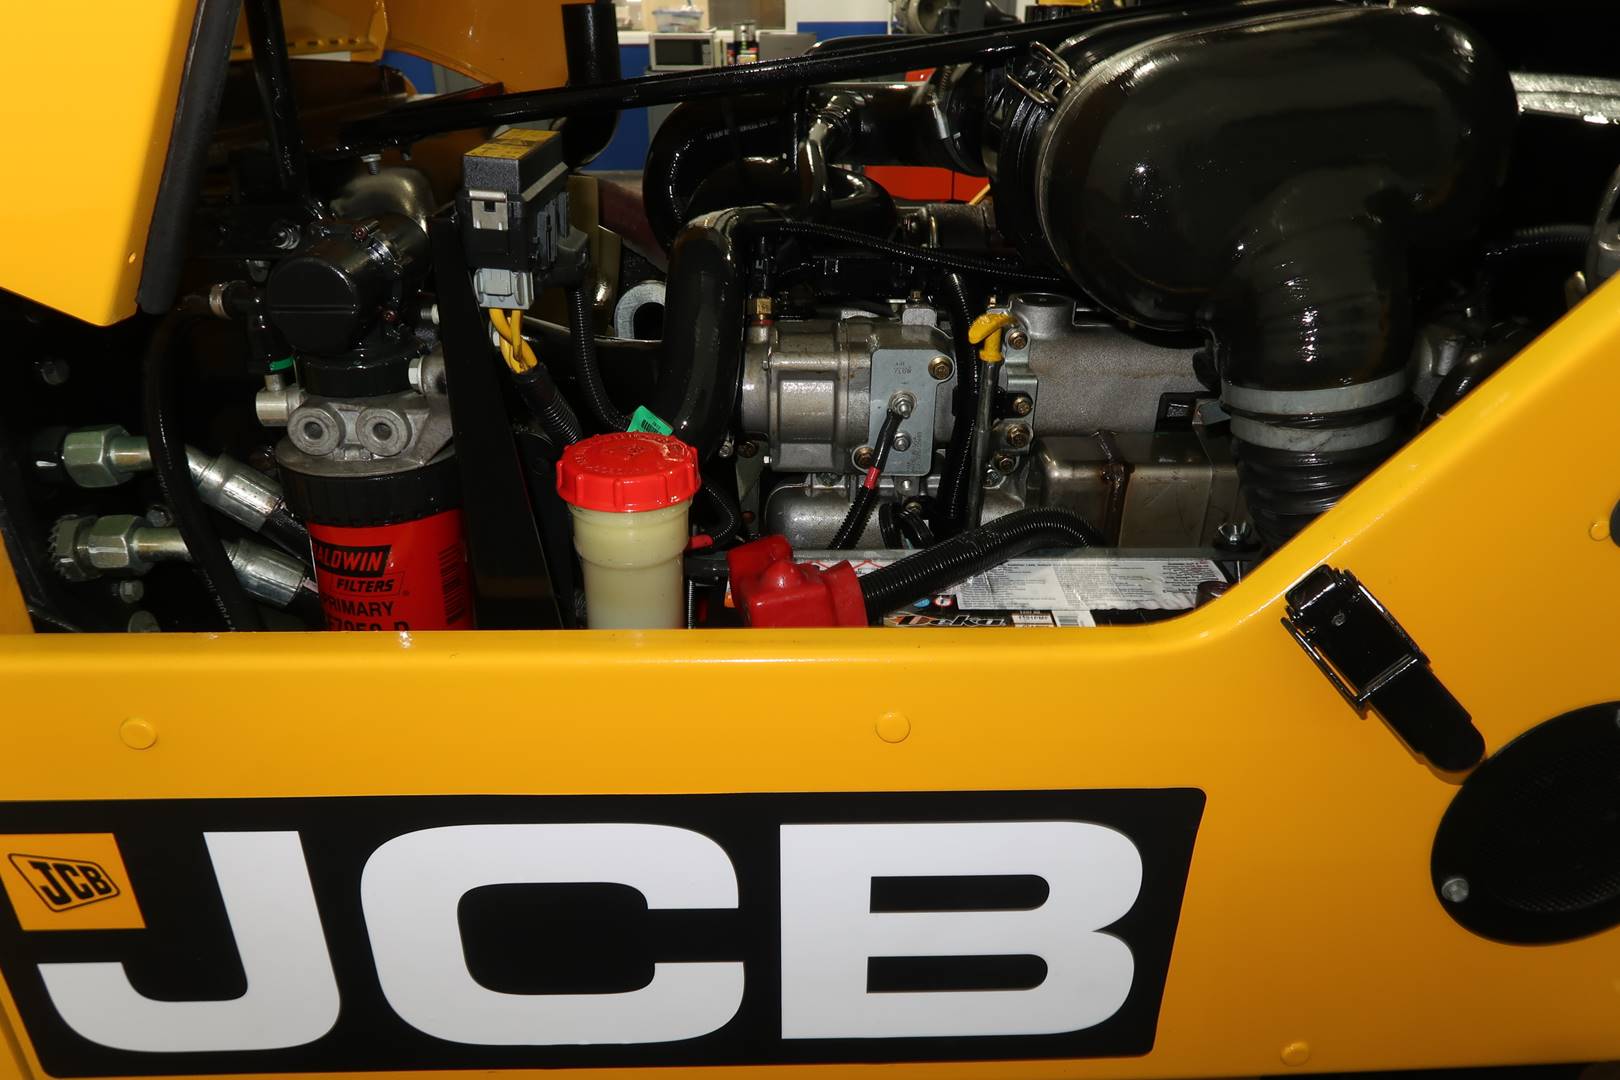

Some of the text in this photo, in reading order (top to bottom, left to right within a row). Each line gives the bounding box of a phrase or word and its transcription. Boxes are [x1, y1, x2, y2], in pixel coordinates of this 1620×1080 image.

[337, 579, 394, 592] FILTERS
[28, 860, 112, 905] JCB
[37, 821, 1143, 1053] JCB
